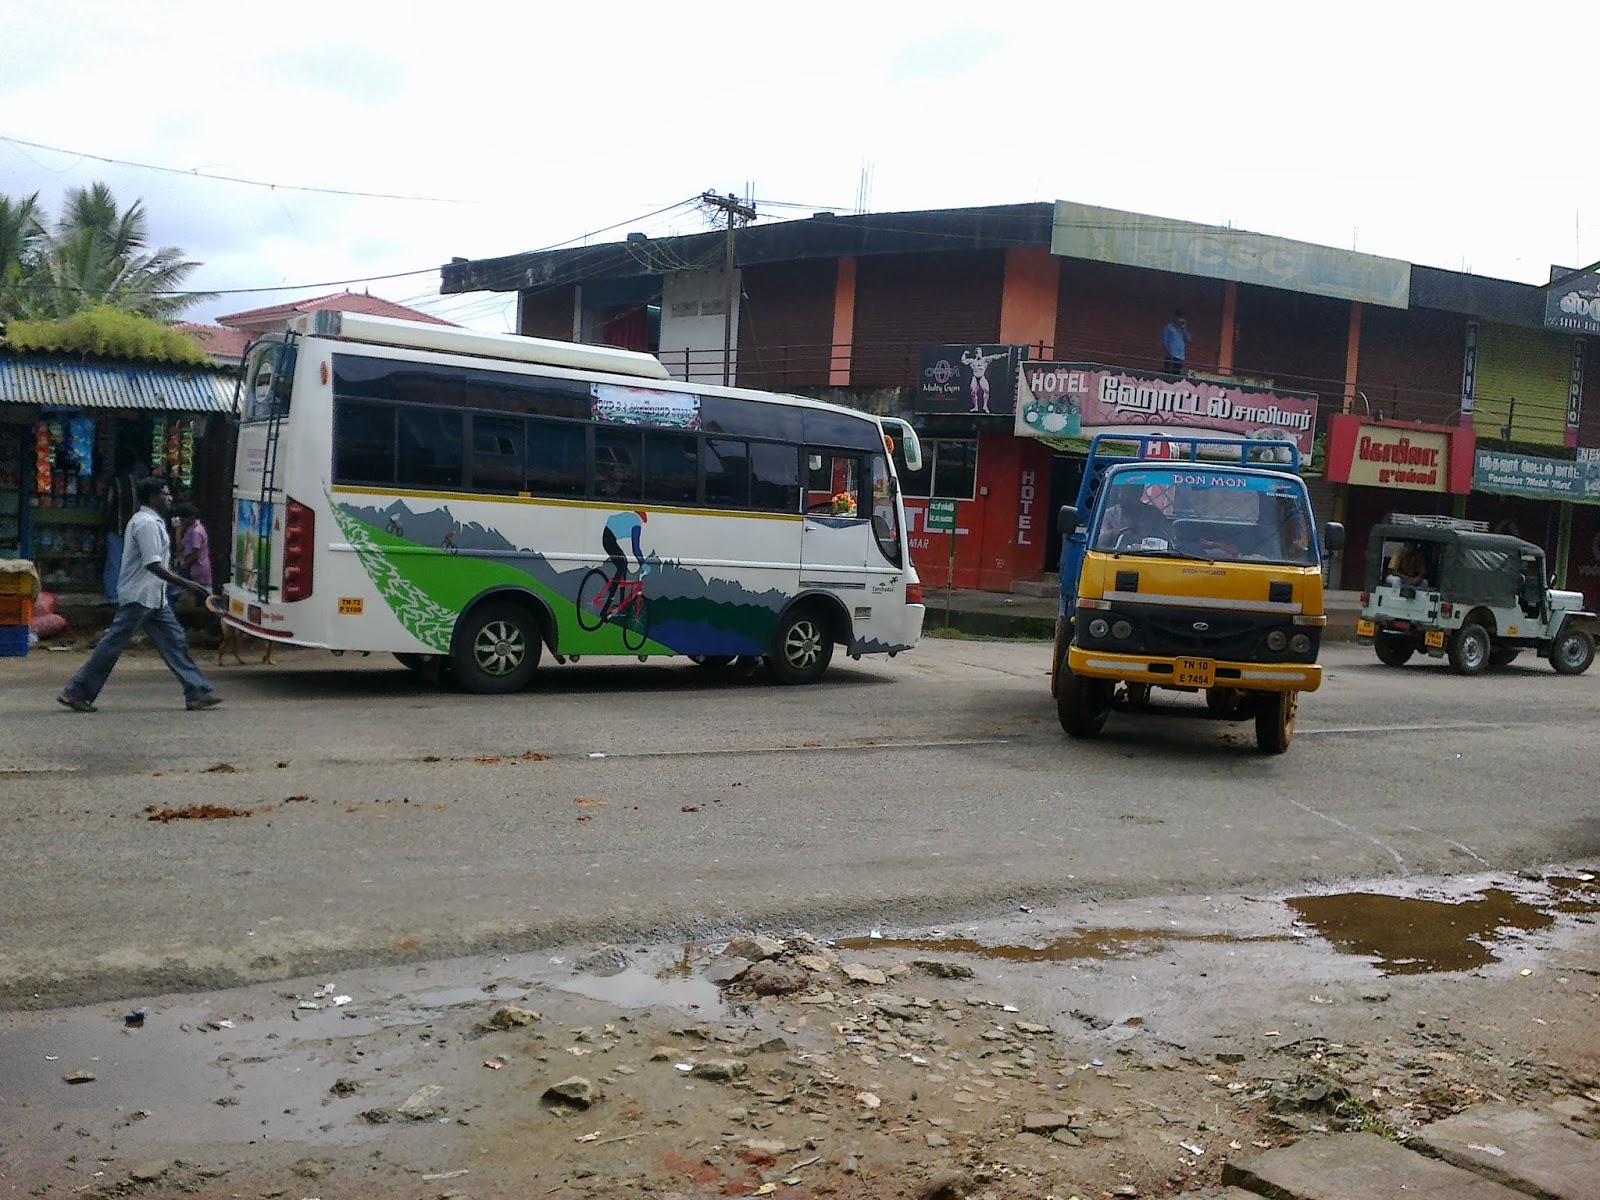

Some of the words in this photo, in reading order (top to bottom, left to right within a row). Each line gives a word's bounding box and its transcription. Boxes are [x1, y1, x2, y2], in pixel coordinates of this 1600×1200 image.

[1031, 372, 1089, 393] HOTEL
[944, 383, 960, 394] Gym
[1173, 474, 1206, 486] DON
[1017, 470, 1035, 545] HOTEL
[1183, 660, 1195, 669] TN
[1197, 662, 1208, 670] 10
[1179, 674, 1185, 682] E
[1188, 675, 1209, 684] 7454
